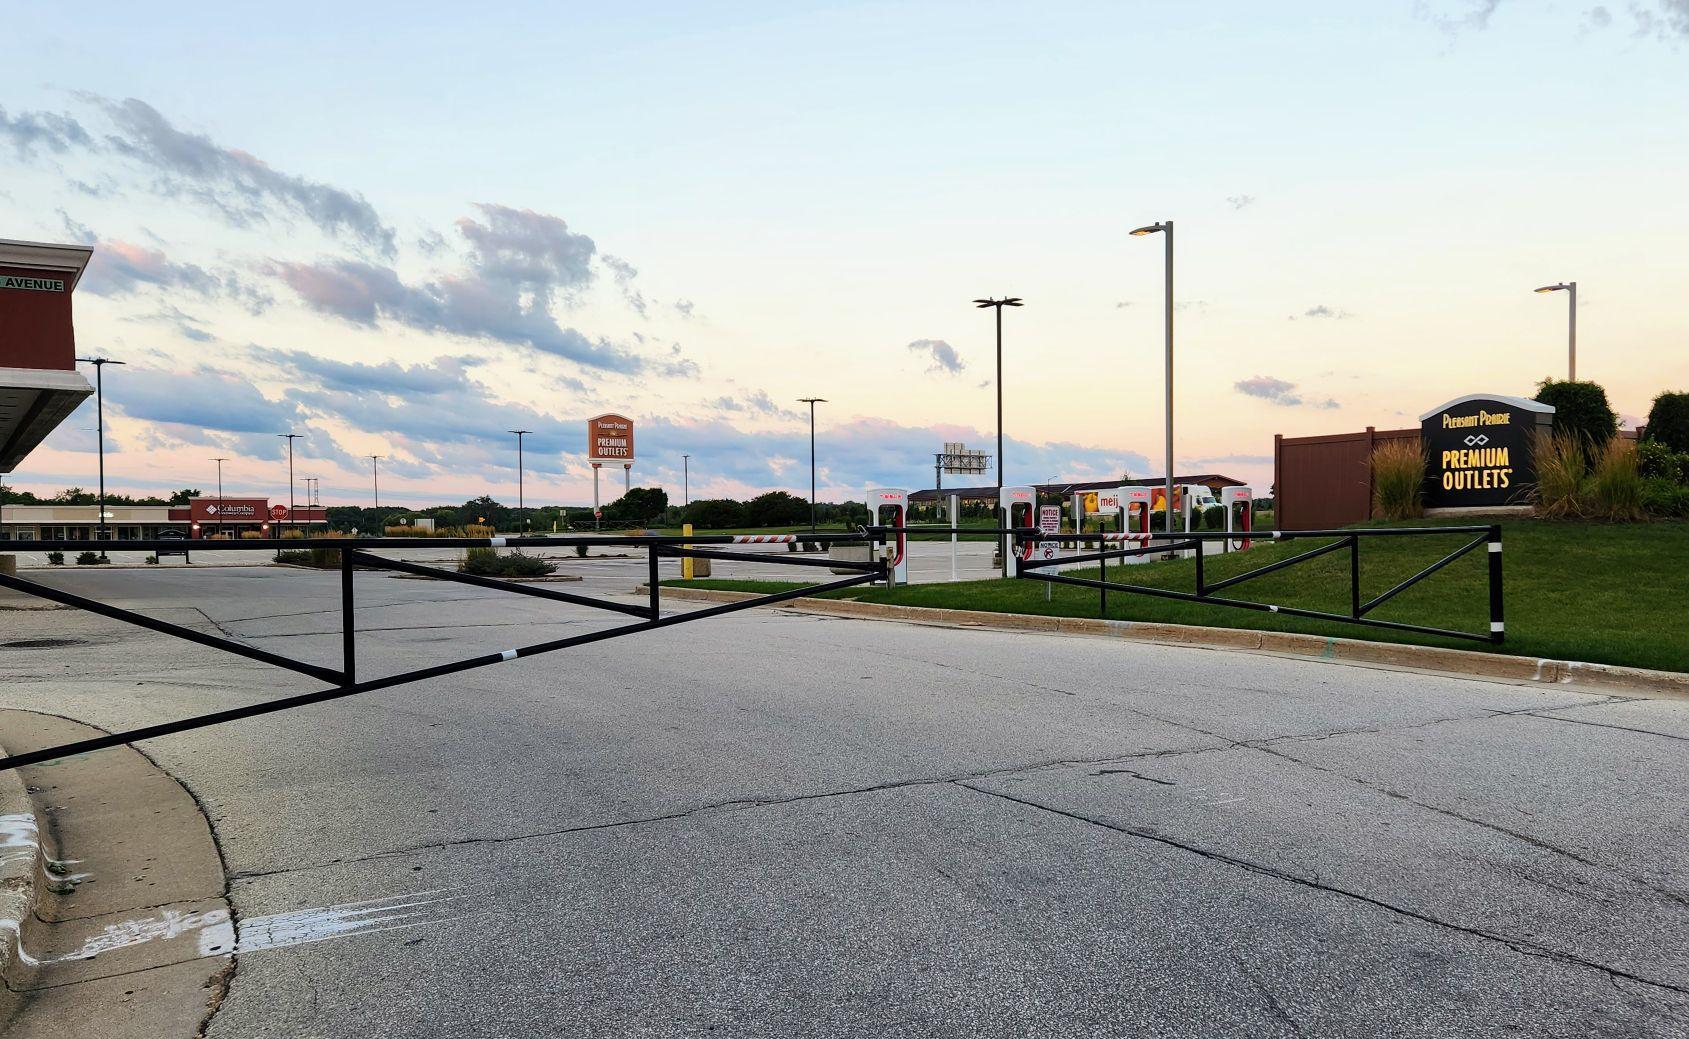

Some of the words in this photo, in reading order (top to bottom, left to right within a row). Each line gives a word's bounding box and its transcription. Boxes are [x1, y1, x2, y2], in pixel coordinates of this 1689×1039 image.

[5, 277, 63, 291] AVENUE
[1442, 413, 1479, 429] PLEASANT
[1479, 410, 1510, 426] PRAIRIE
[597, 437, 627, 447] PREMIUM
[598, 447, 627, 456] OUTLETS
[1442, 446, 1510, 469] PREMIUM
[1100, 494, 1119, 509] meij
[217, 503, 255, 512] Columbia
[271, 508, 287, 516] STOP
[1042, 508, 1058, 516] NOTICE
